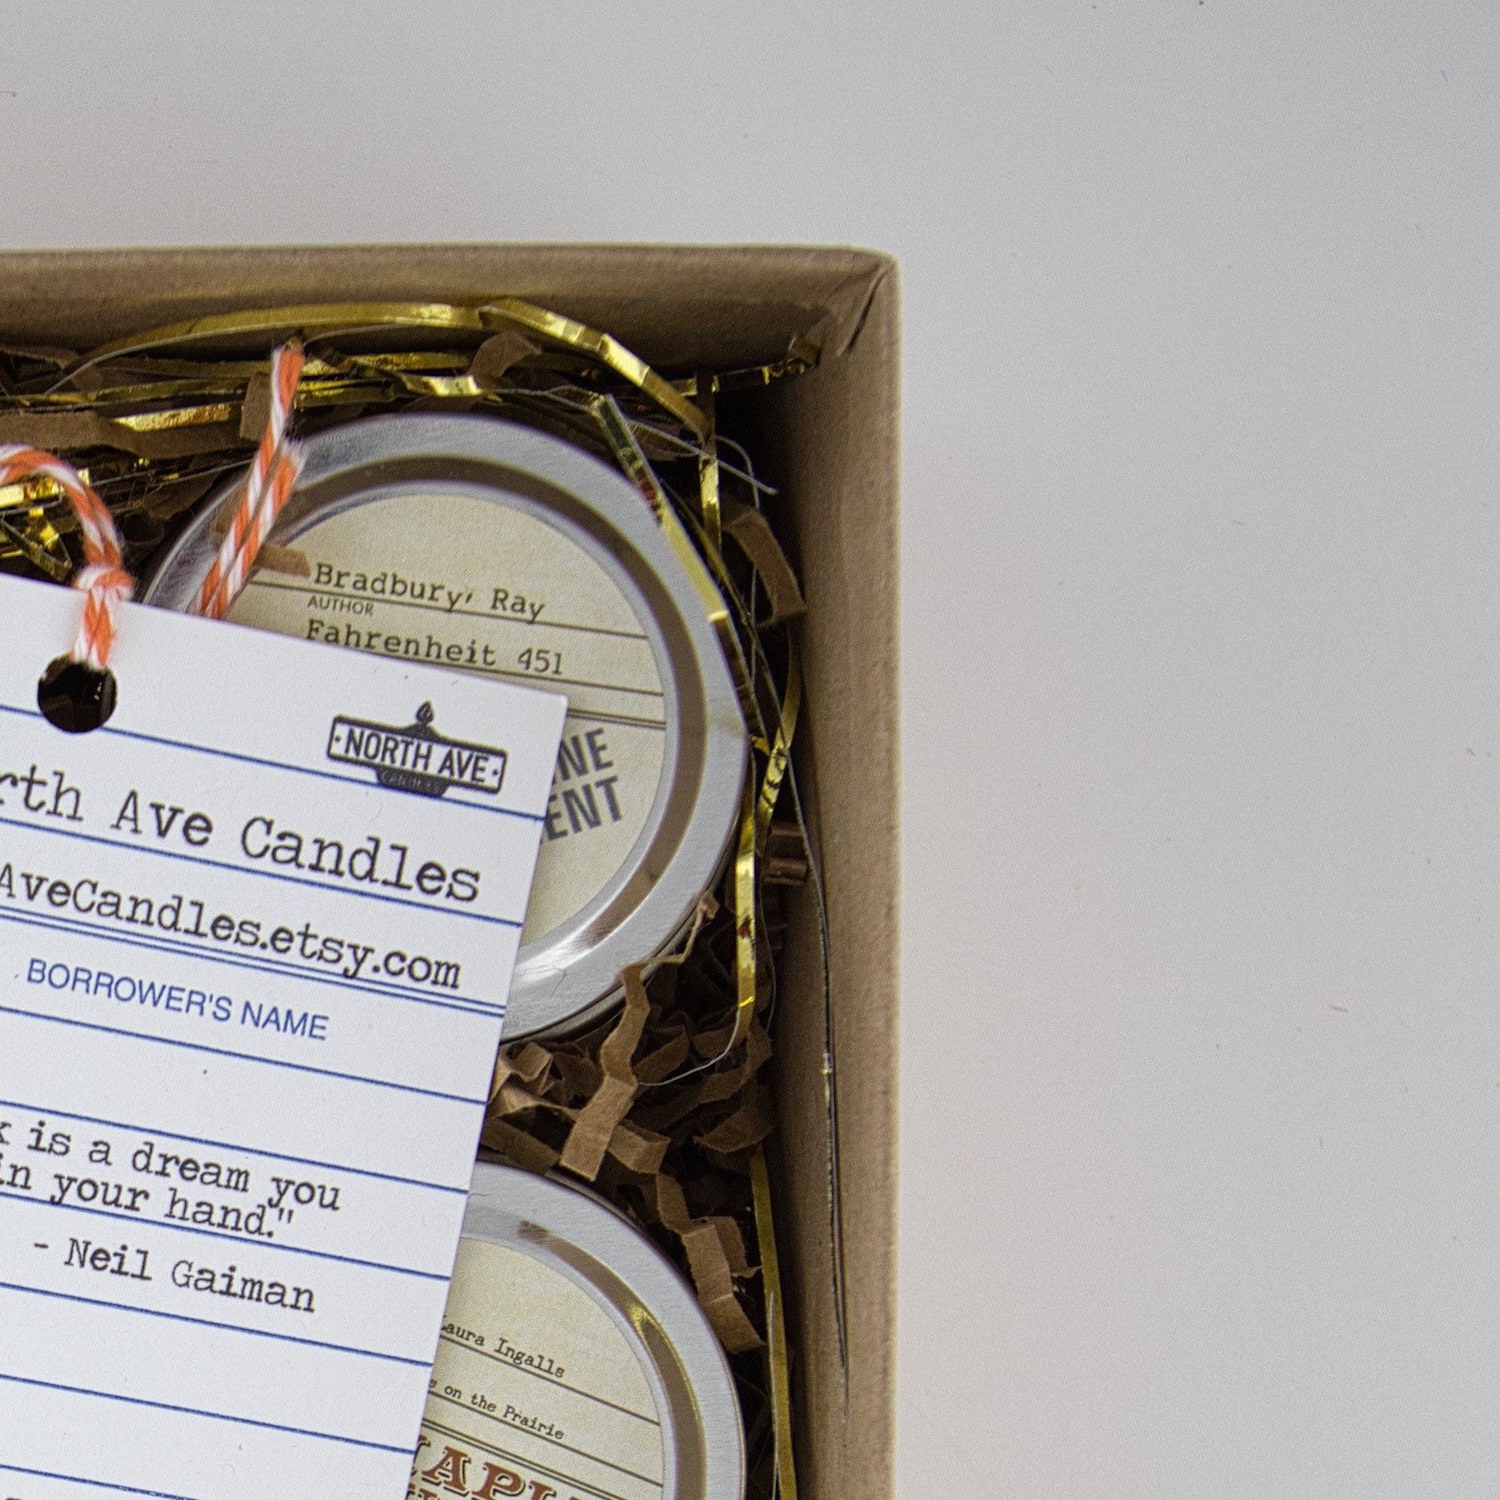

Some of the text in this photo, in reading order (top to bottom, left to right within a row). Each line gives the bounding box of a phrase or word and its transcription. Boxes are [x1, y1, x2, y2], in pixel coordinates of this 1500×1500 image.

[306, 595, 375, 617] AUTHOR
[490, 588, 546, 624] Ray
[305, 618, 564, 676] Fahrenheit 451
[344, 727, 490, 784] NORTH AVE
[553, 727, 615, 785] NE
[111, 791, 214, 848] Ave
[240, 815, 482, 903] Candles
[26, 957, 330, 1042] BORROWER'S NAME
[26, 1121, 72, 1157] is
[88, 1138, 113, 1167] a
[132, 1141, 251, 1193] dream
[268, 1172, 341, 1212] you
[49, 1172, 150, 1214] your
[164, 1187, 294, 1240] hand."
[64, 1237, 153, 1283] Neil
[171, 1259, 317, 1314] Gaiman
[494, 1337, 566, 1379] Ingalls
[443, 1384, 566, 1441] on the Prairie
